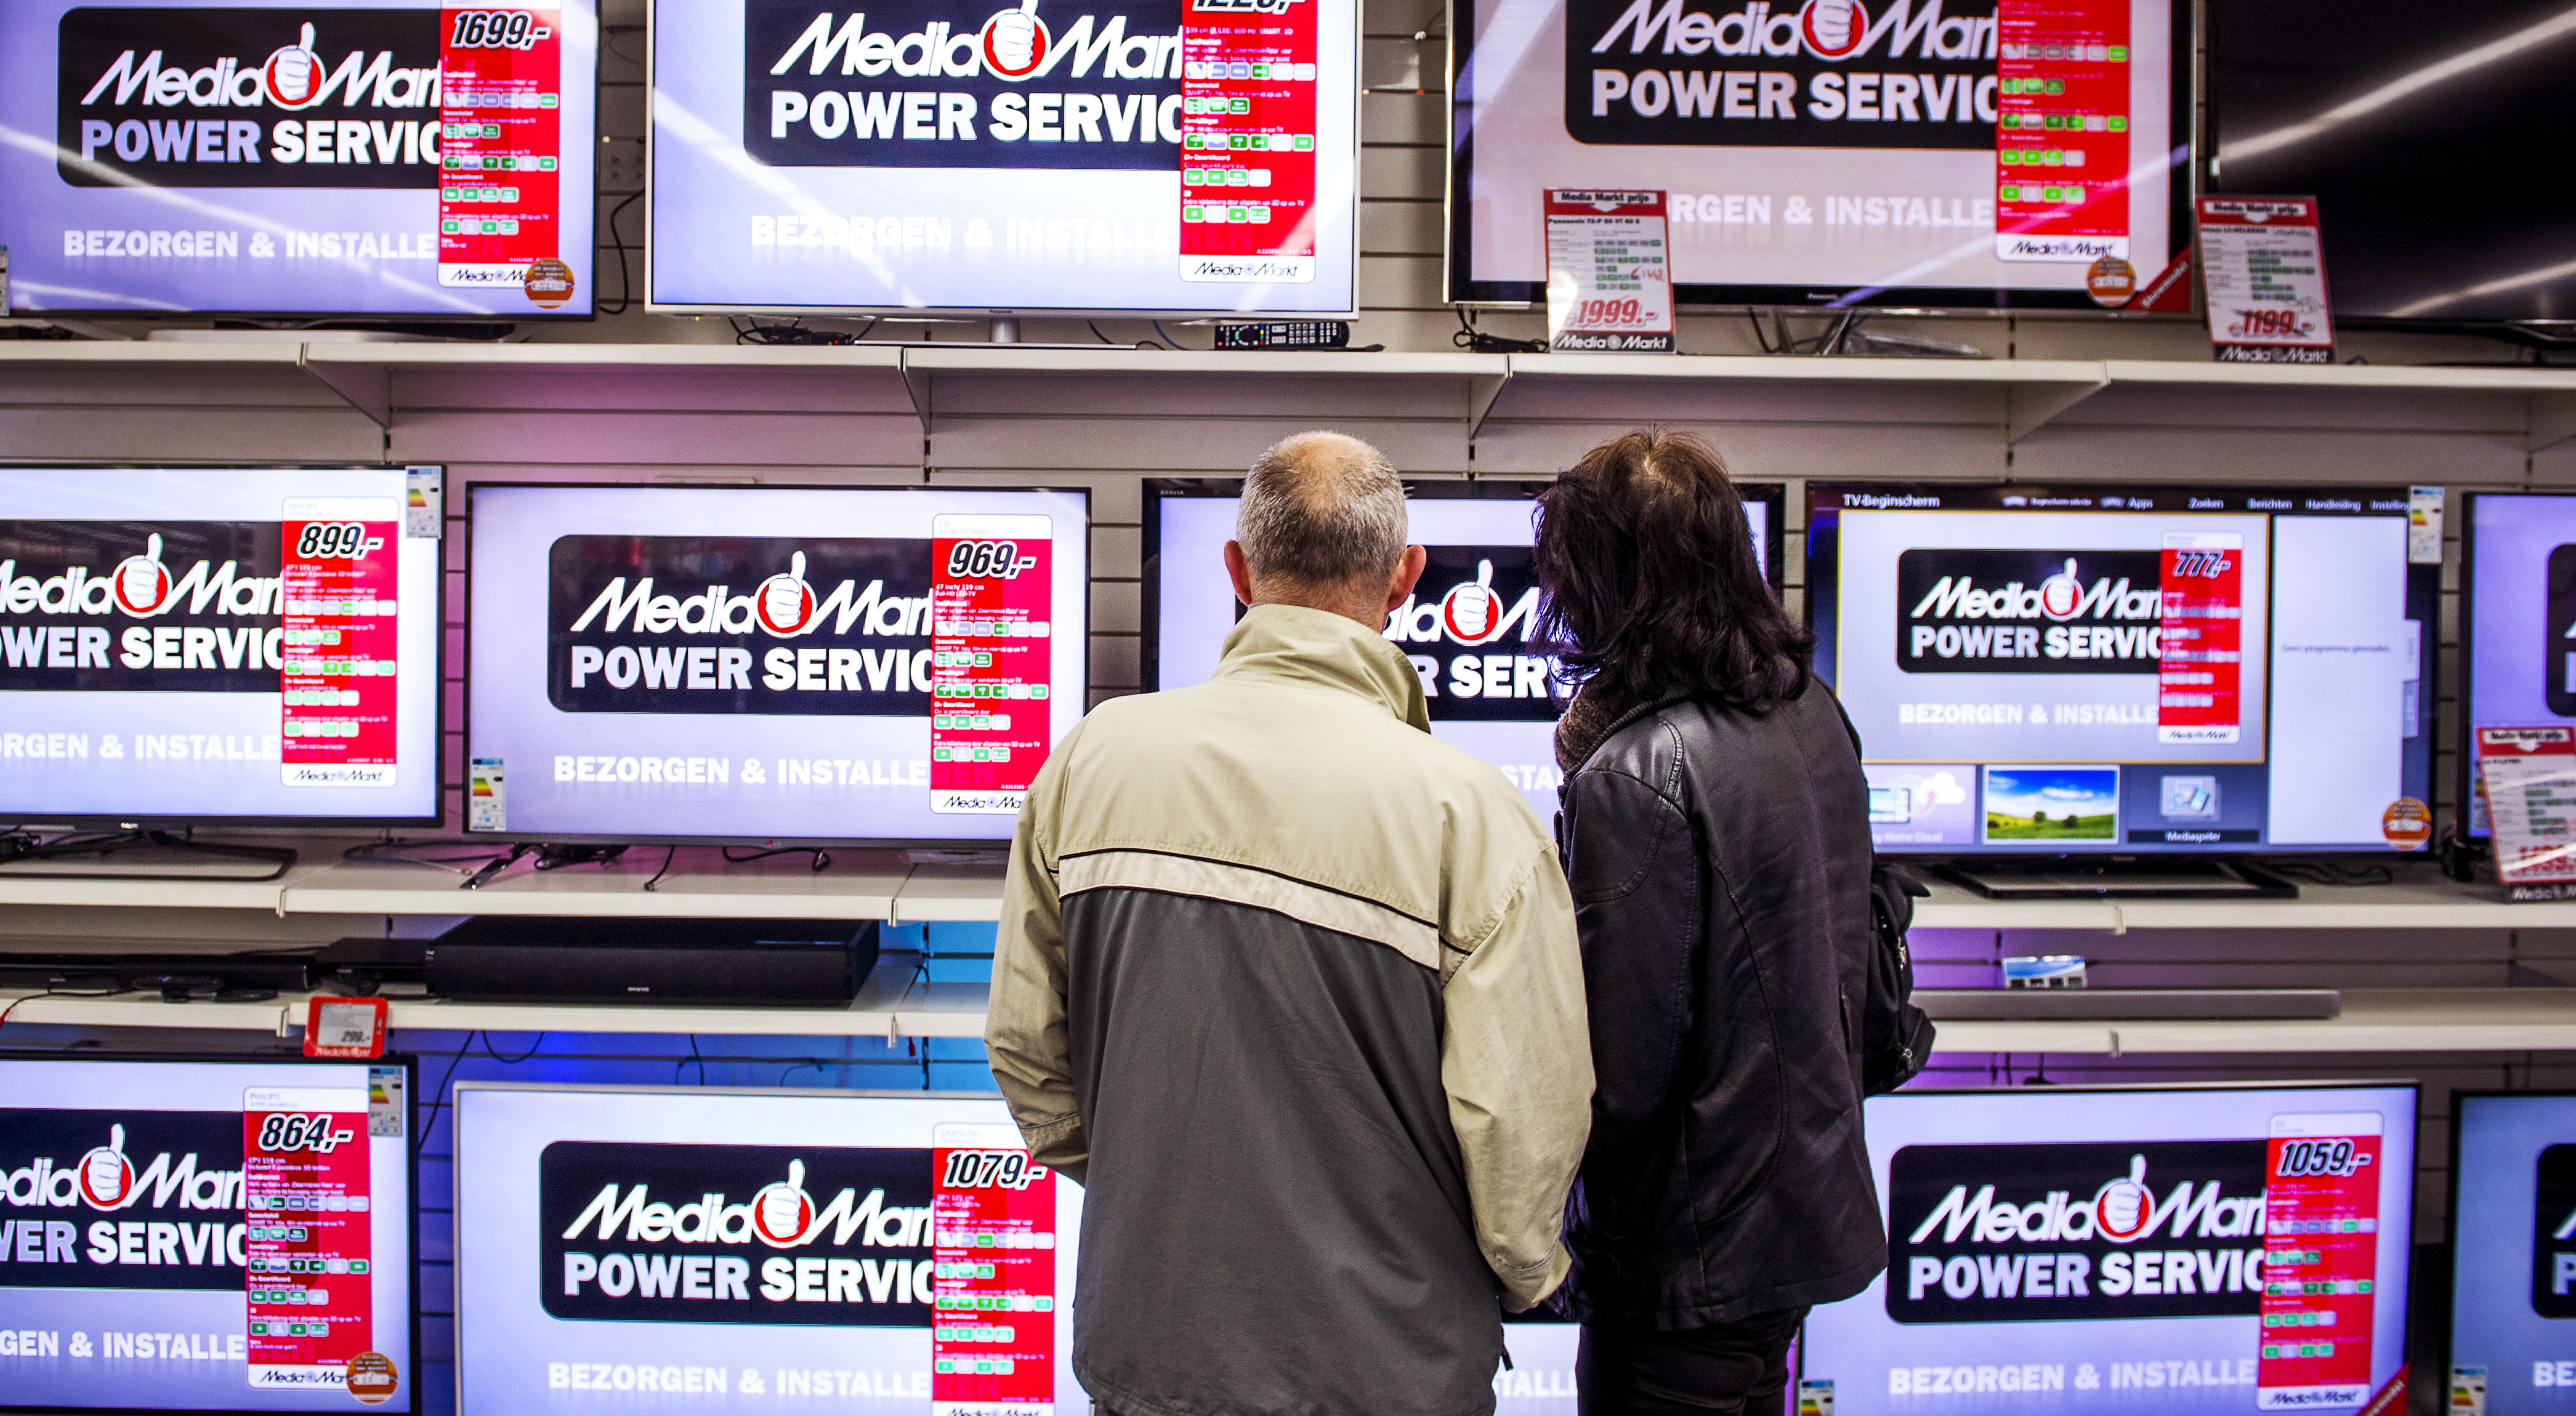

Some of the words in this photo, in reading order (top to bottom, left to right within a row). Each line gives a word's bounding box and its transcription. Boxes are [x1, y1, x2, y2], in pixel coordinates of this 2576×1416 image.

[451, 11, 551, 50] 1699,-
[770, 12, 985, 78] Media
[81, 50, 265, 107] Media
[1592, 69, 1798, 118] POWER
[1809, 74, 1998, 123] SERVIC
[772, 91, 978, 140] POWER
[990, 92, 1182, 143] SERVIC
[82, 120, 261, 163] POWER
[271, 121, 440, 164] SERVIC
[1561, 192, 1592, 201] Media
[1595, 193, 1625, 201] Markt
[1783, 195, 1813, 226] &
[64, 230, 238, 257] BEZORGEN
[249, 230, 275, 257] &
[751, 215, 951, 247] BEZORGEN
[963, 215, 994, 247] &
[2010, 241, 2059, 255] Media
[451, 269, 494, 281] Media
[1194, 262, 1243, 275] Media
[1254, 263, 1298, 276] Markt
[1577, 299, 1656, 326] 1999.-
[1557, 334, 1606, 349] Media
[1622, 336, 1667, 350] Markt
[2218, 346, 2271, 361] Media
[1843, 494, 1940, 509] TV-Beginscherm
[2128, 498, 2154, 509] Apps
[2189, 498, 2224, 509] Zoeken
[2248, 499, 2293, 510] Berichten
[2306, 499, 2361, 512] Handleiding
[297, 522, 384, 560] 899,-
[948, 541, 1037, 579] 969,-
[2171, 549, 2232, 579] 777,-
[571, 576, 756, 634] Media
[1912, 576, 2042, 619] Media
[121, 627, 283, 669] SERVIC
[1912, 626, 2039, 658] POWER
[2043, 627, 2162, 659] SERVIC
[571, 646, 753, 690] POWER
[763, 648, 932, 693] SERVIC
[1900, 704, 2027, 724] BEZORGEN
[2030, 704, 2048, 724] &
[99, 734, 125, 760] &
[293, 770, 335, 781] Media
[554, 756, 730, 784] BEZORGEN
[740, 757, 767, 785] &
[943, 796, 985, 808] Media
[2165, 831, 2221, 843] Mediaspeler
[258, 1113, 354, 1153] 864,-
[942, 1150, 1048, 1190] 1079,-
[2275, 1139, 2372, 1178] 1059,-
[563, 1183, 752, 1243] Media
[1909, 1184, 2095, 1244] Media
[87, 1222, 246, 1268] SERVIC
[564, 1252, 750, 1301] POWER
[760, 1258, 934, 1305] SERVIC
[1909, 1253, 2090, 1300] POWER
[2099, 1249, 2264, 1295] SERVIC
[68, 1330, 94, 1359] &
[260, 1370, 305, 1383] Media
[549, 1363, 729, 1395] BEZORGEN
[741, 1366, 766, 1396] &
[1889, 1365, 2065, 1395] BEZORGEN
[2076, 1364, 2101, 1390] &
